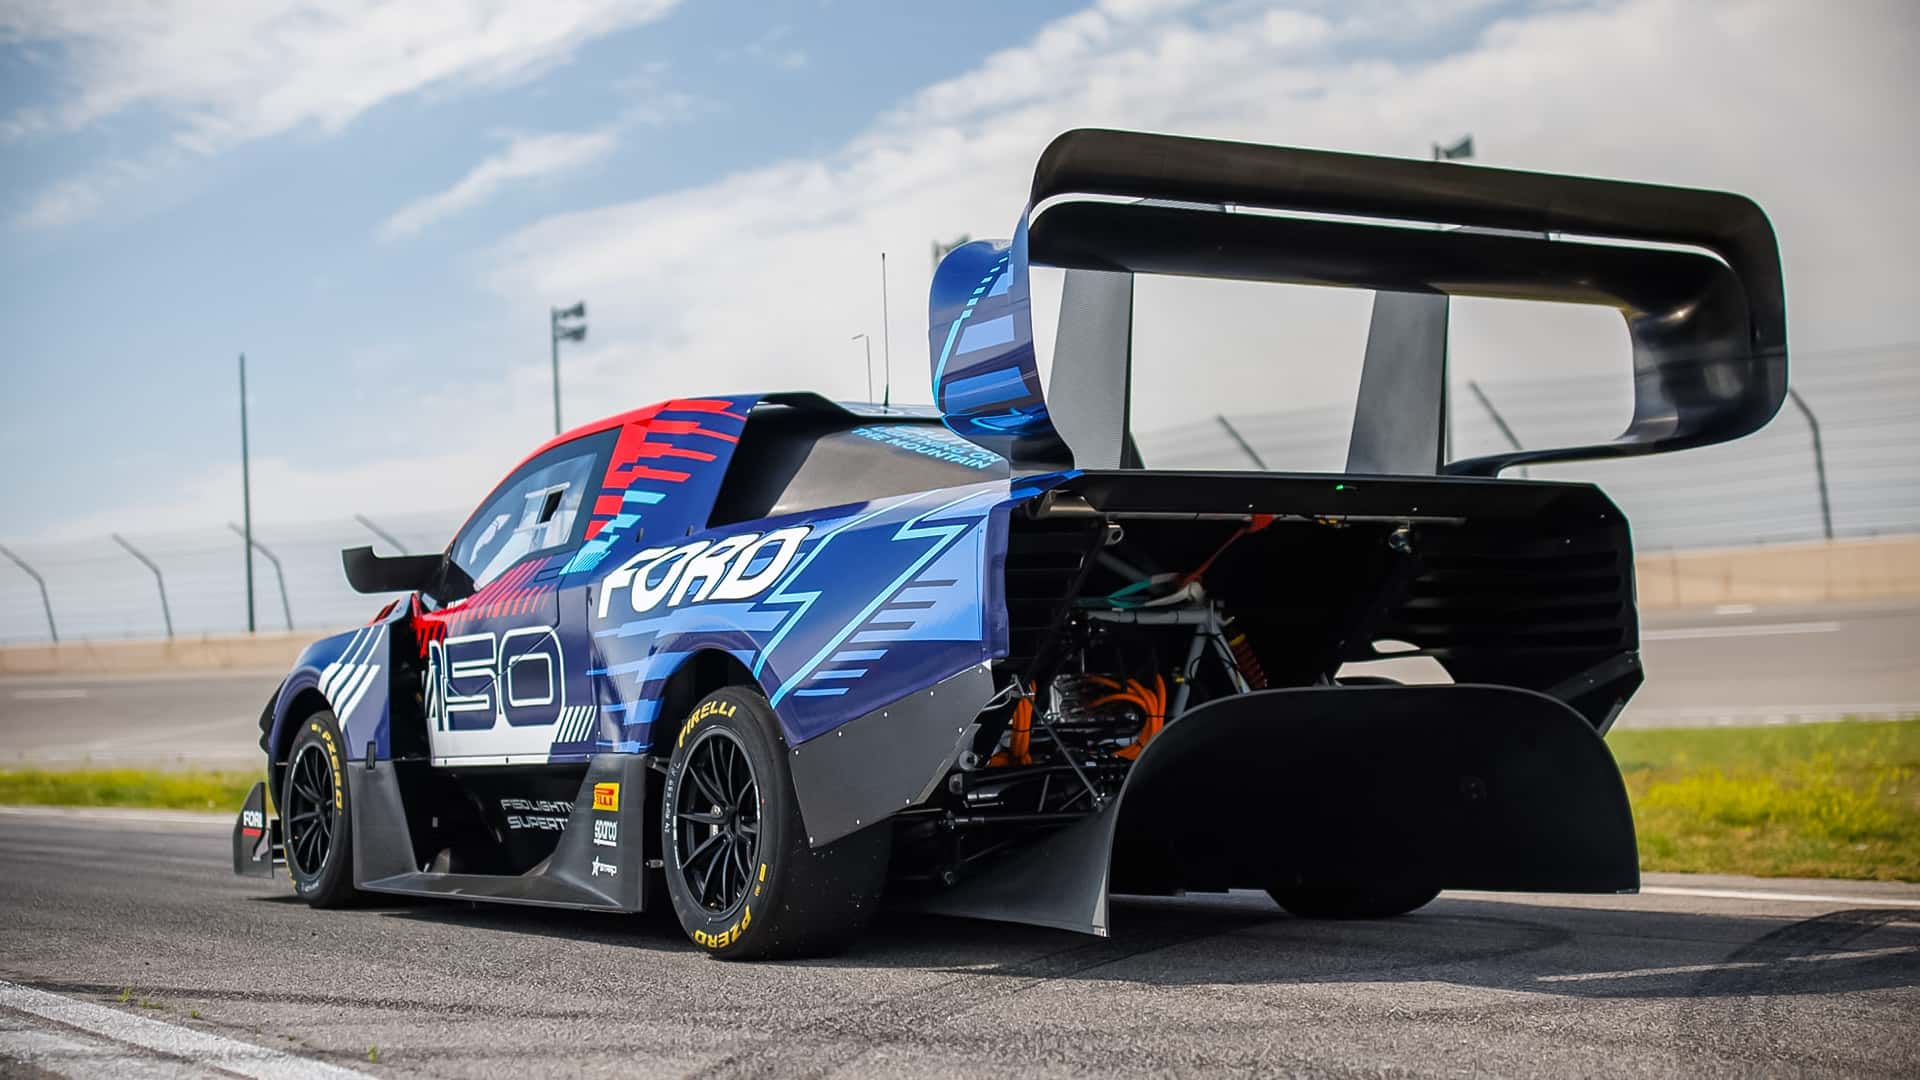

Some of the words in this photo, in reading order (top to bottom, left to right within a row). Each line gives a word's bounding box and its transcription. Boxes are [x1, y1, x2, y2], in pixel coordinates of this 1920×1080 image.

[850, 427, 889, 442] THE
[885, 436, 993, 470] MOUNTAIN
[971, 450, 1001, 463] ON
[597, 525, 813, 619] FORD
[678, 700, 737, 749] PIRELLI
[507, 816, 569, 831] SUPERT
[694, 904, 752, 949] PZERO
